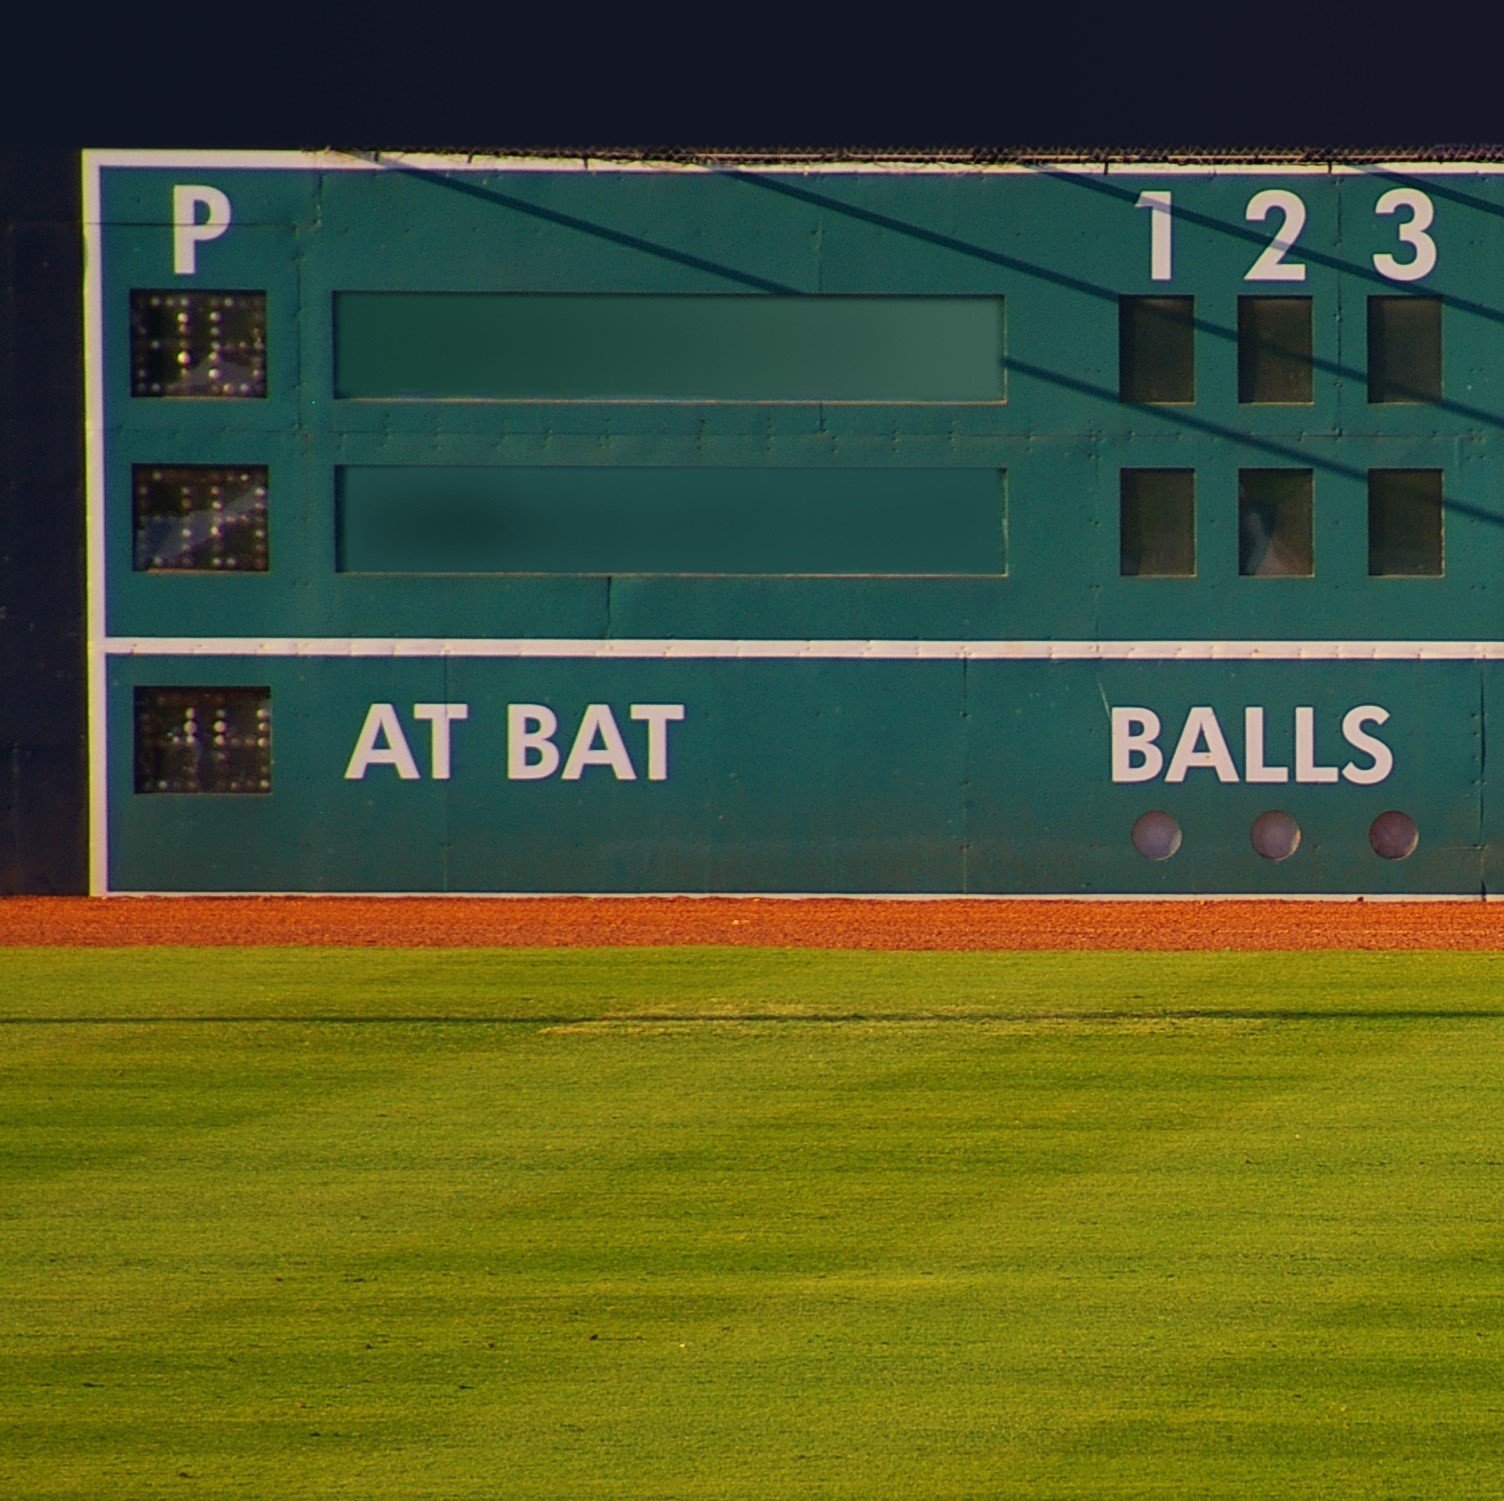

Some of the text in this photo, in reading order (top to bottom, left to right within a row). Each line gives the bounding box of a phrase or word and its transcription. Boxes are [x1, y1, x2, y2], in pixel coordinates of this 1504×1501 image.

[171, 184, 232, 275] P
[1134, 189, 1173, 282] 1
[1243, 188, 1307, 282] 2
[1373, 187, 1438, 282] 3
[343, 702, 686, 782] AT BAT
[1110, 705, 1394, 786] BALLS
